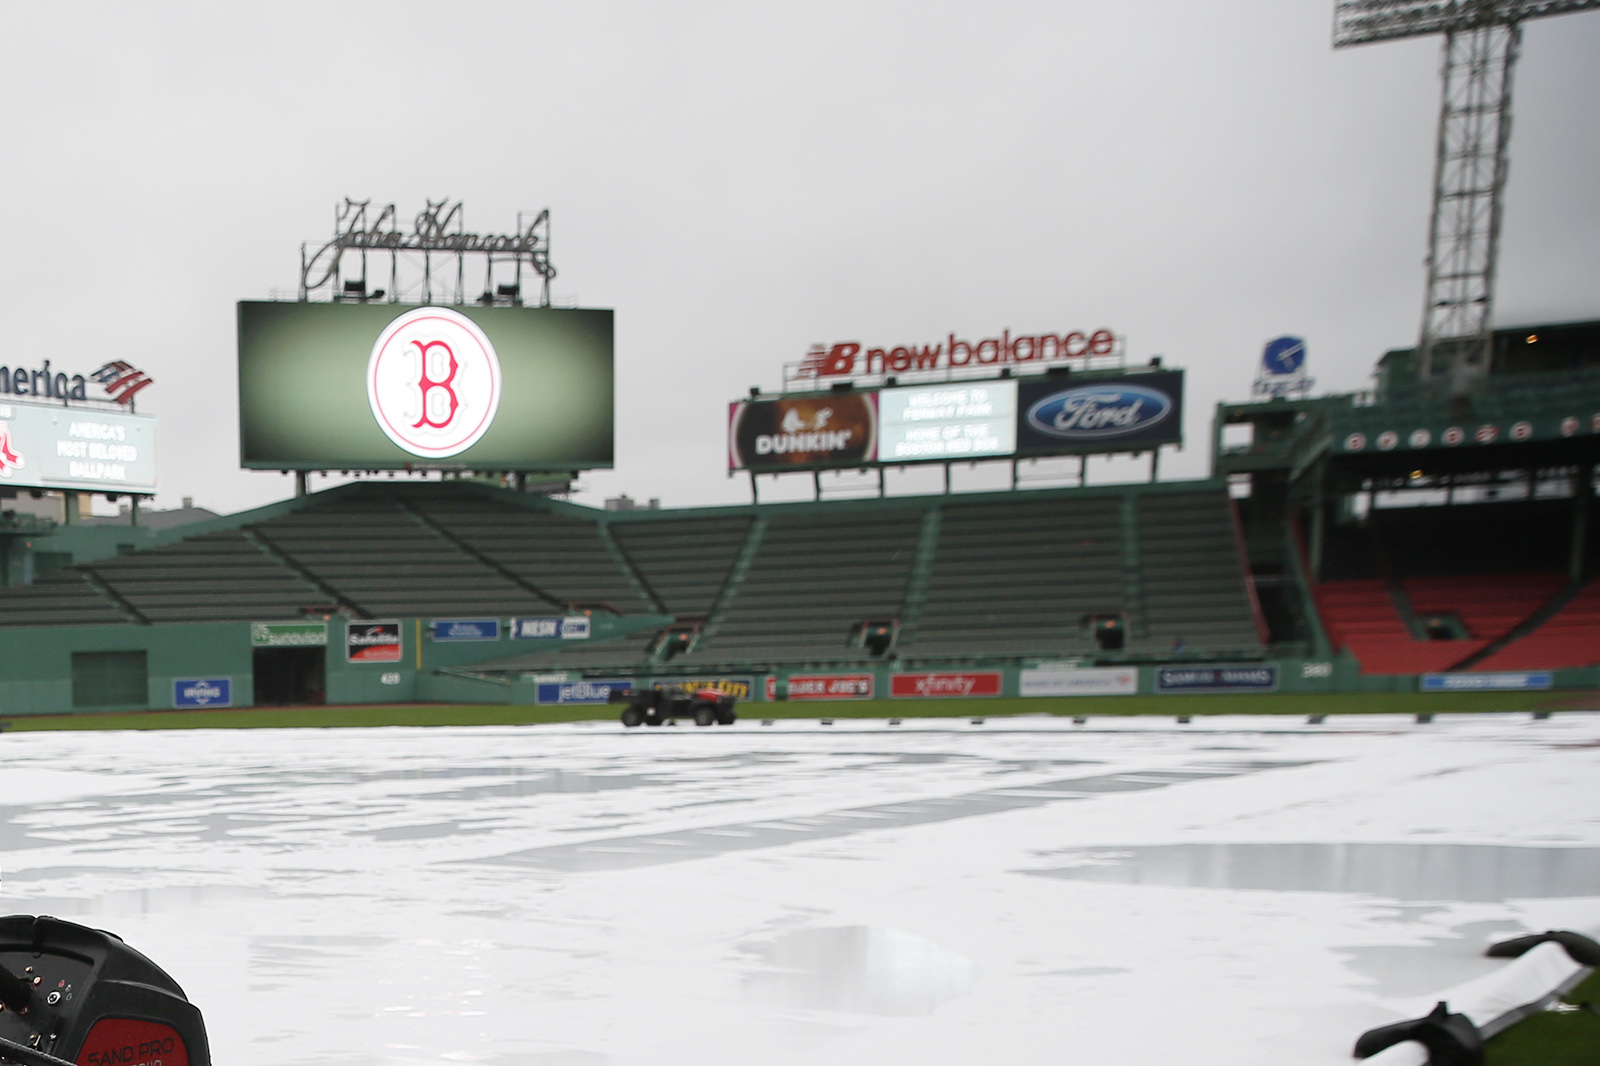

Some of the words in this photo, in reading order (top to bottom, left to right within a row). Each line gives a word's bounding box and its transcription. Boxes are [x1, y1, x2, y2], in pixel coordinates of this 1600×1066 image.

[866, 343, 941, 374] new
[948, 329, 1114, 367] balance
[908, 390, 967, 406] WELCOME
[970, 389, 988, 402] TO
[903, 405, 954, 421] FENWAY
[956, 402, 993, 418] PARK
[1053, 393, 1142, 430] Ford
[755, 430, 852, 455] DUNKIN'
[905, 426, 940, 441] HOME
[895, 440, 944, 456] BOSTON
[946, 437, 971, 453] RED
[558, 682, 611, 703] jetBlue
[138, 1037, 174, 1058] PRO
